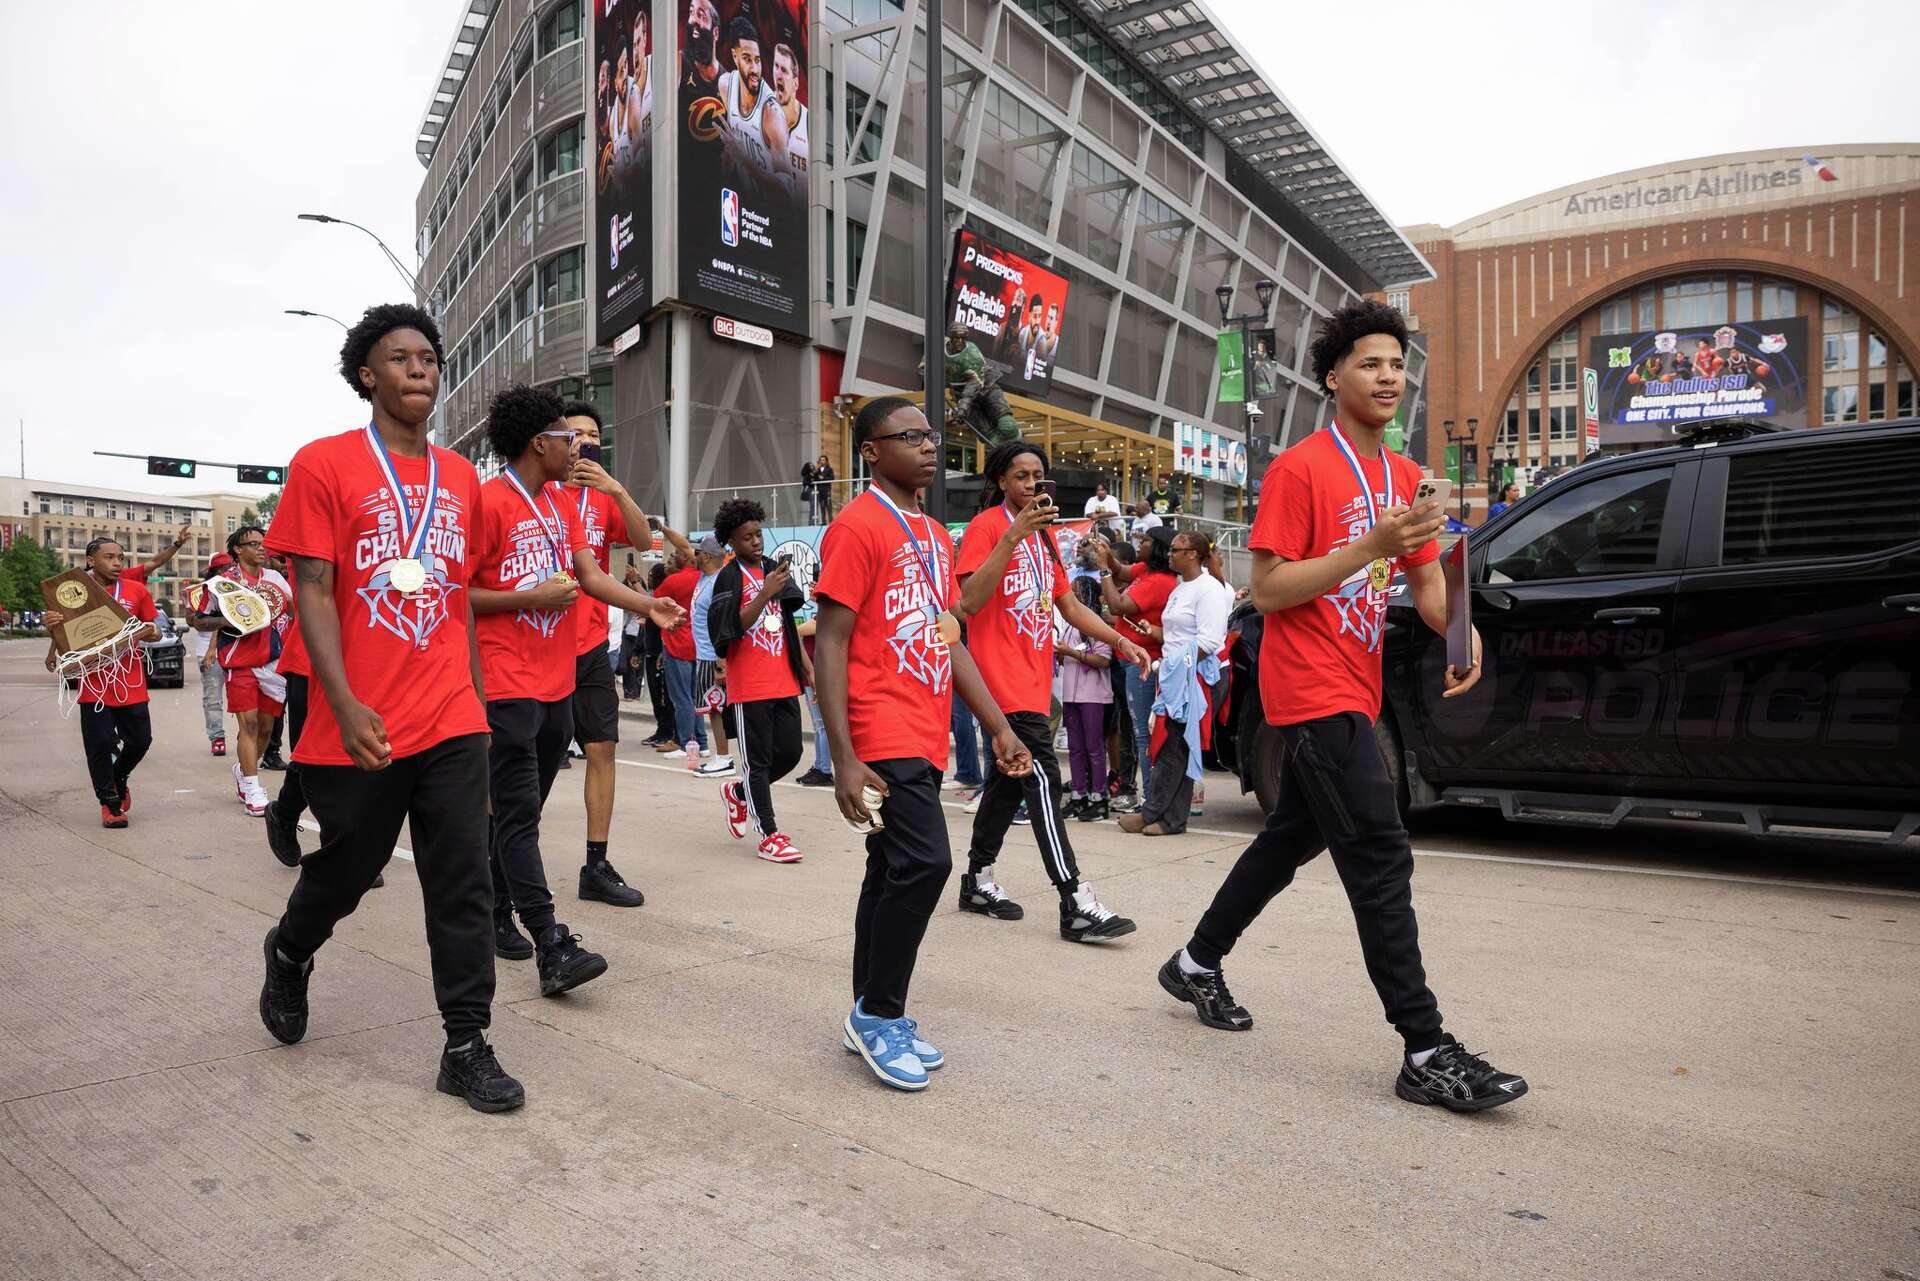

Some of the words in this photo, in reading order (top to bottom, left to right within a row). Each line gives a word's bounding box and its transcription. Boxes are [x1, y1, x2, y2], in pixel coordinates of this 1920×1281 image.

[1564, 183, 1689, 216] American
[1693, 167, 1802, 199] Airlines
[741, 208, 770, 226] Preferred
[741, 219, 764, 234] Partner
[741, 230, 748, 238] of
[749, 232, 759, 242] the
[760, 235, 773, 248] NBA
[975, 254, 1024, 285] PRIZEPICKS
[957, 284, 1006, 319] Available
[716, 320, 734, 335] BIG
[735, 324, 771, 343] OUTDOOR
[967, 308, 999, 337] Dallas
[1645, 381, 1670, 396] The
[1672, 377, 1720, 395] Dallas
[1721, 374, 1748, 390] ISD
[1630, 391, 1716, 409] Championship
[1717, 388, 1762, 403] Parade
[1625, 409, 1647, 422] ONE
[1647, 407, 1671, 421] CITY.
[1674, 405, 1701, 419] FOUR
[1703, 402, 1768, 417] CHAMPIONS.
[1501, 629, 1608, 656] DALLAS
[1614, 628, 1665, 656] ISD
[1524, 669, 1911, 746] POLICE
